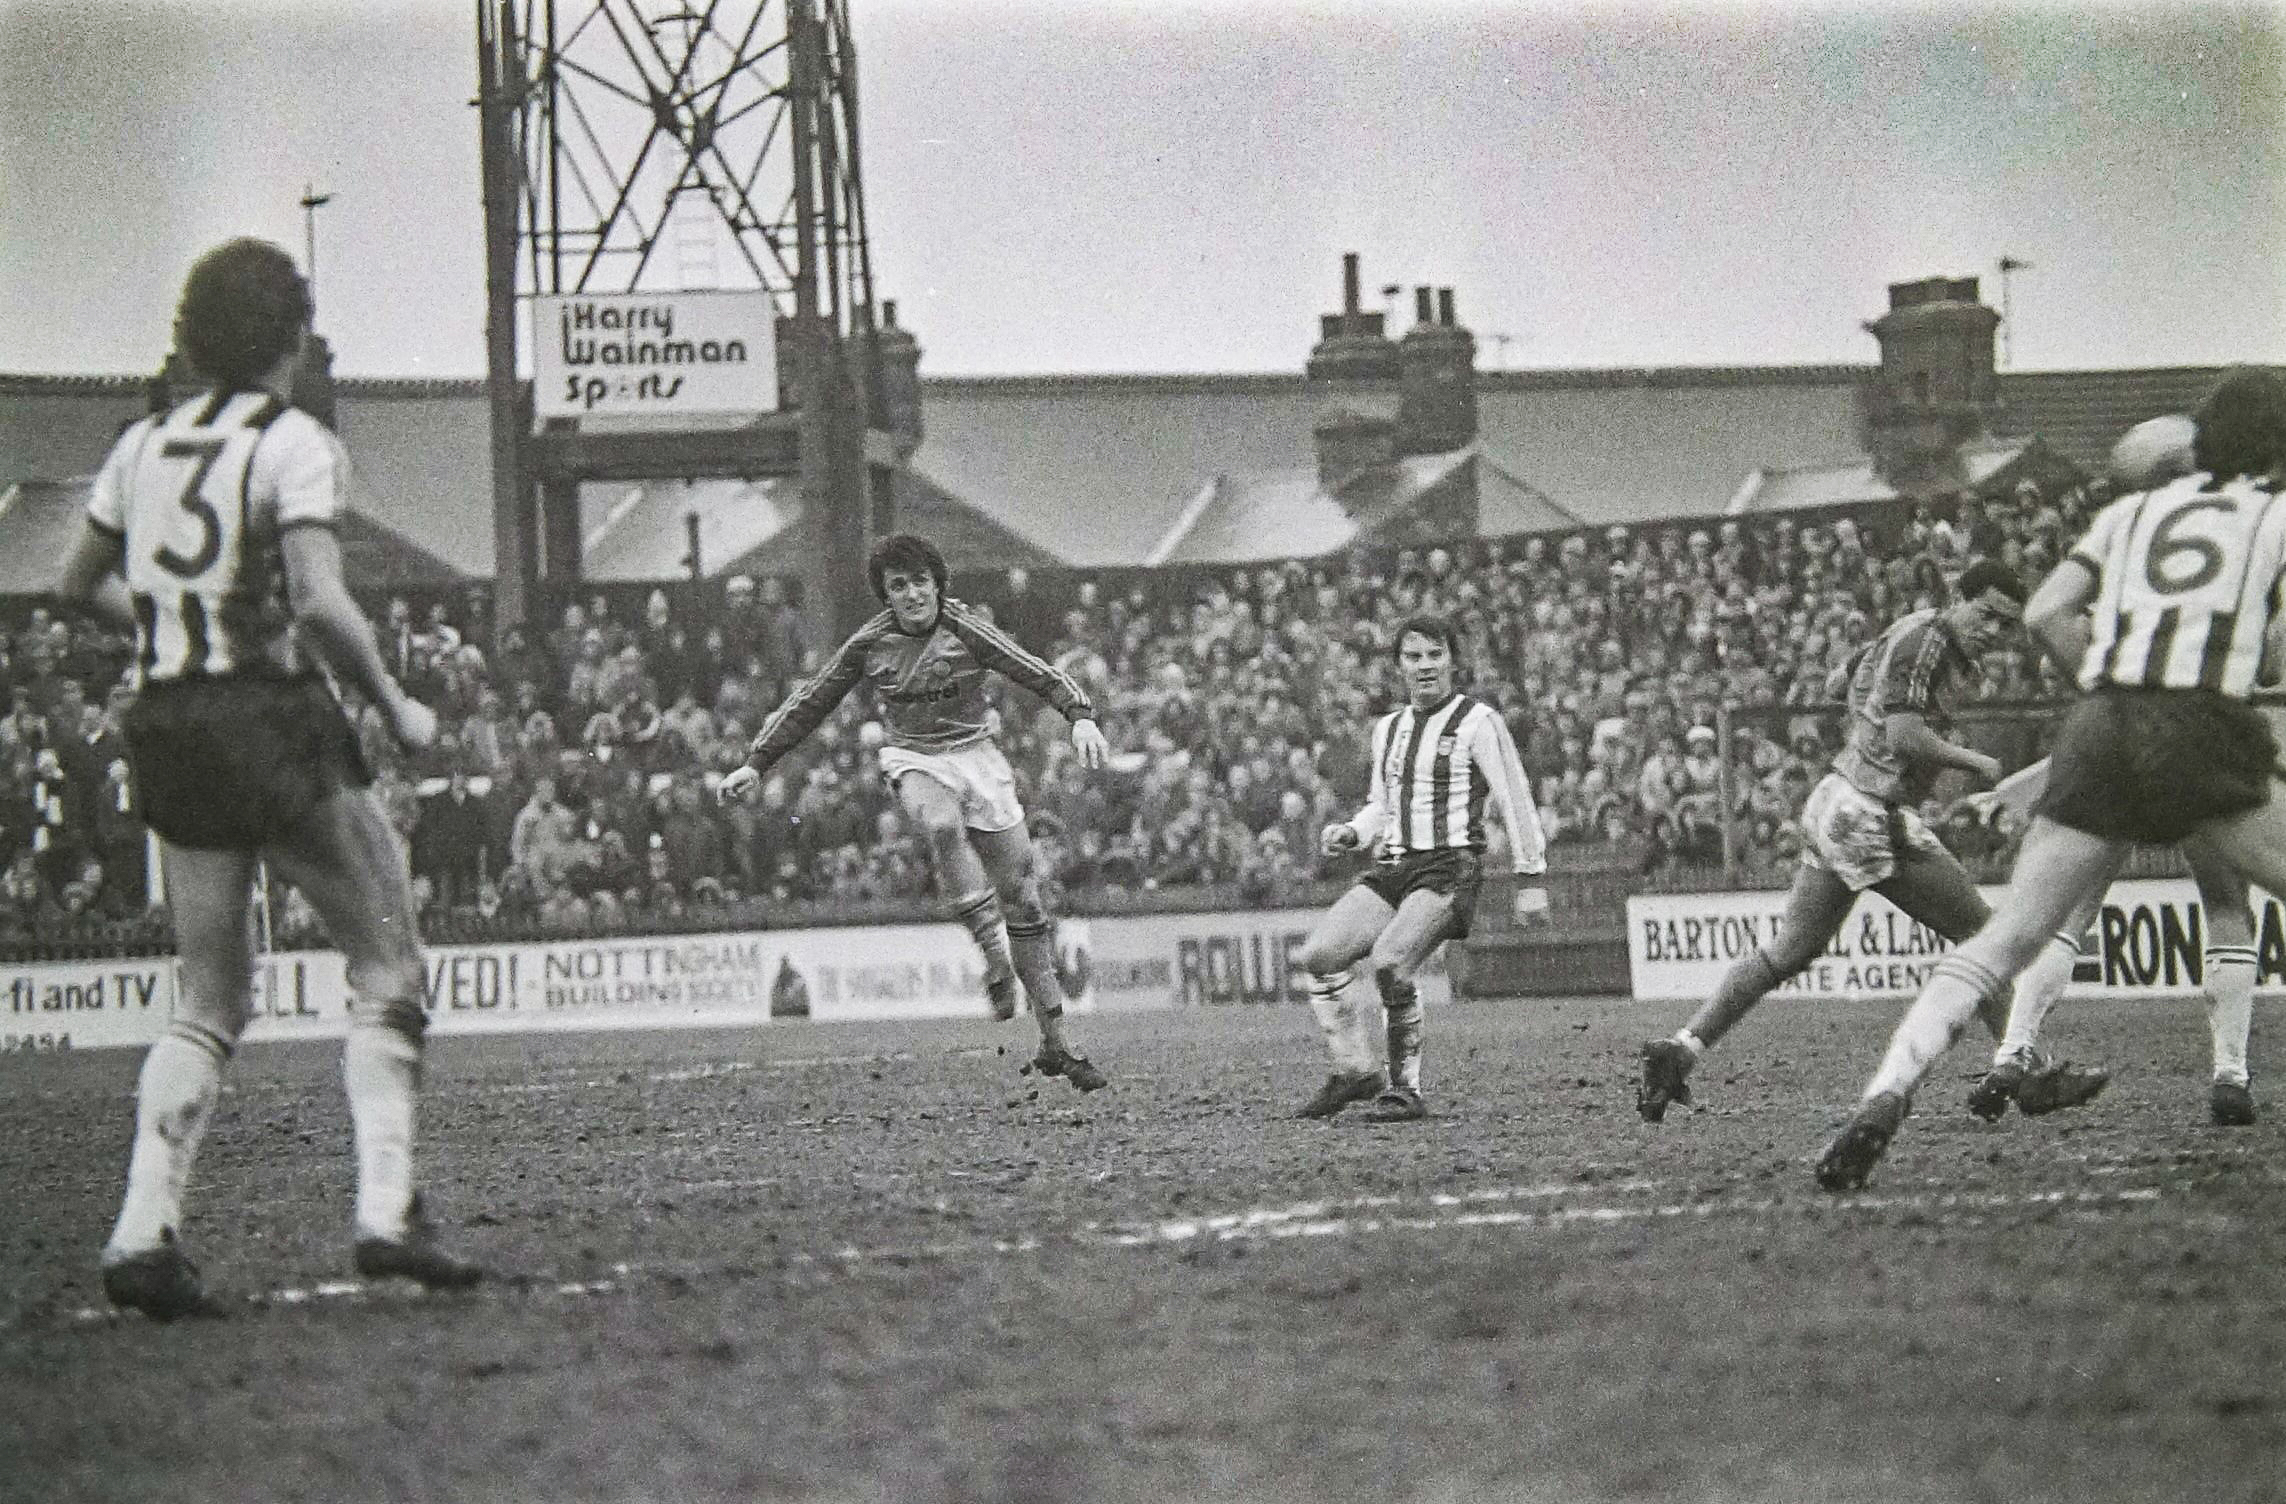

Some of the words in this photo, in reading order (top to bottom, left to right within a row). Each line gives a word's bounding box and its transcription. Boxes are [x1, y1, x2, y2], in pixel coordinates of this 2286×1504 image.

[574, 303, 673, 337] Harry
[562, 325, 748, 366] Wainman
[566, 373, 684, 409] Sprts
[153, 438, 223, 579] 3
[2146, 497, 2239, 596] 6
[1644, 915, 1758, 961] BARTON
[1859, 911, 1882, 956] &
[2101, 902, 2203, 987] RON
[43, 975, 104, 1011] and
[113, 971, 157, 1009] TV
[1778, 965, 1833, 991] ATE
